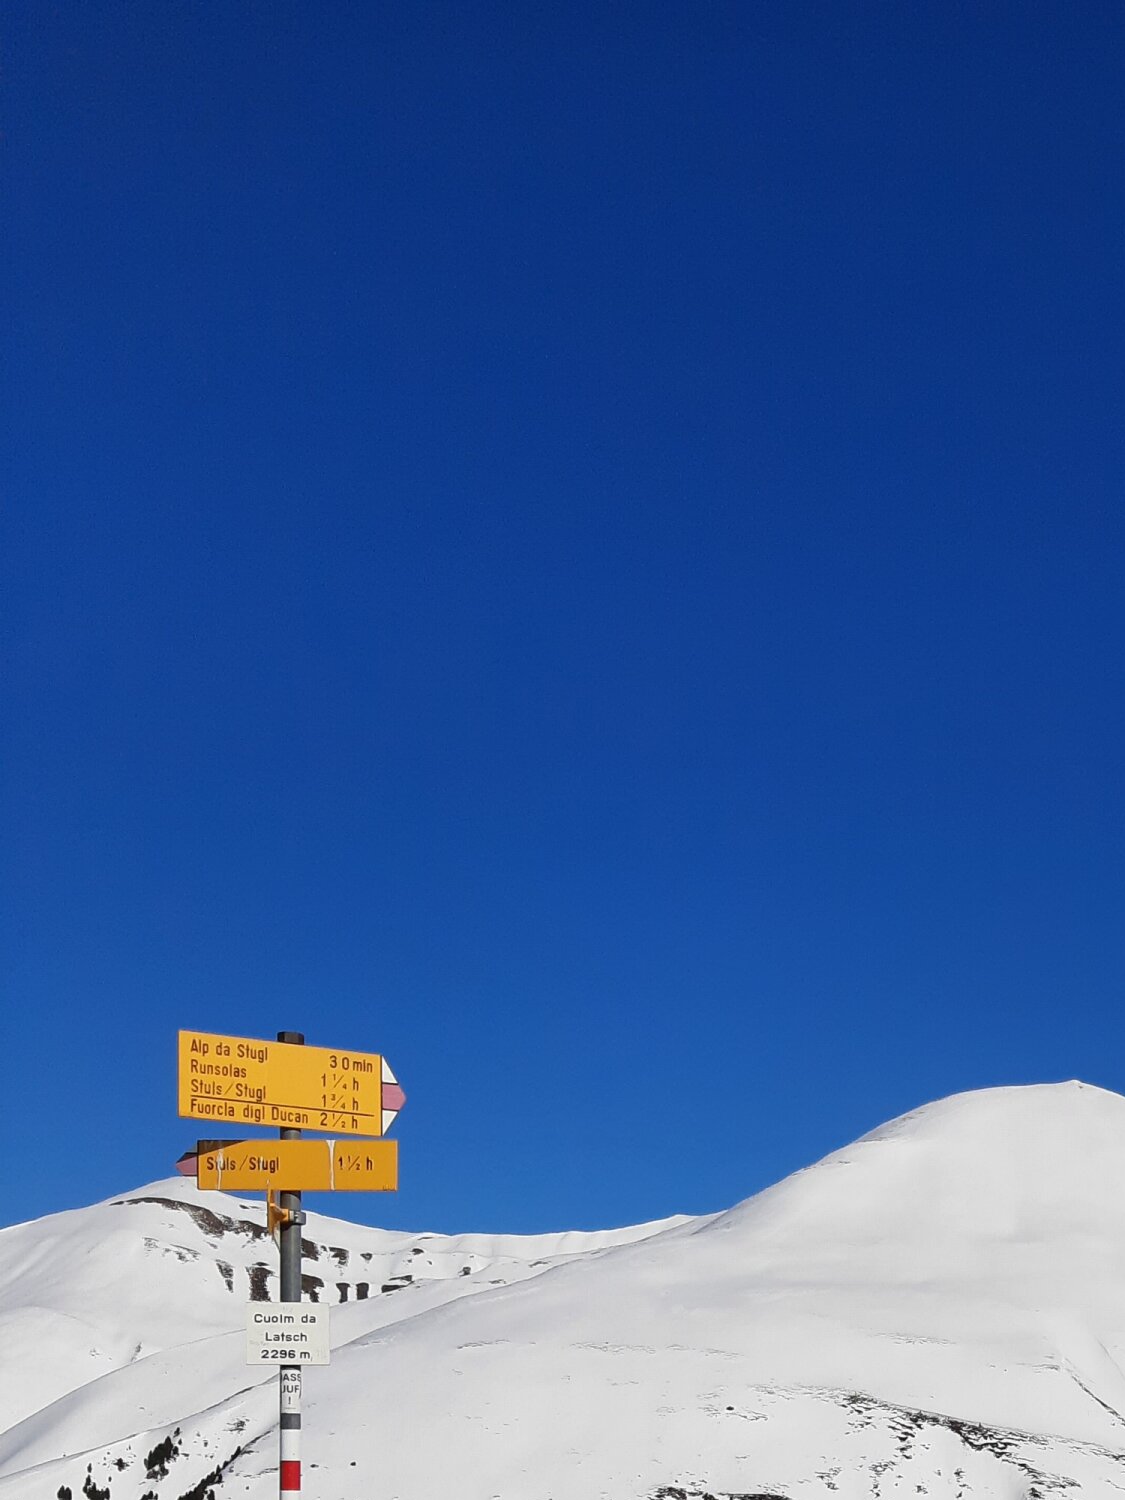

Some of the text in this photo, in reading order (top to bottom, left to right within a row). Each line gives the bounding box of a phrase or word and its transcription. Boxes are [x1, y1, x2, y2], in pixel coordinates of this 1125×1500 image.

[190, 1038, 268, 1062] Alp da Stugl
[190, 1059, 247, 1078] Runsolas
[352, 1058, 373, 1073] min
[352, 1076, 359, 1091] h
[190, 1099, 309, 1124] Fuorcla digl Ducan
[351, 1097, 359, 1111] h
[351, 1115, 359, 1129] h
[366, 1156, 373, 1171] h
[254, 1313, 317, 1324] Cuolm da
[265, 1331, 308, 1342] Latsch
[260, 1349, 311, 1359] 2296 m
